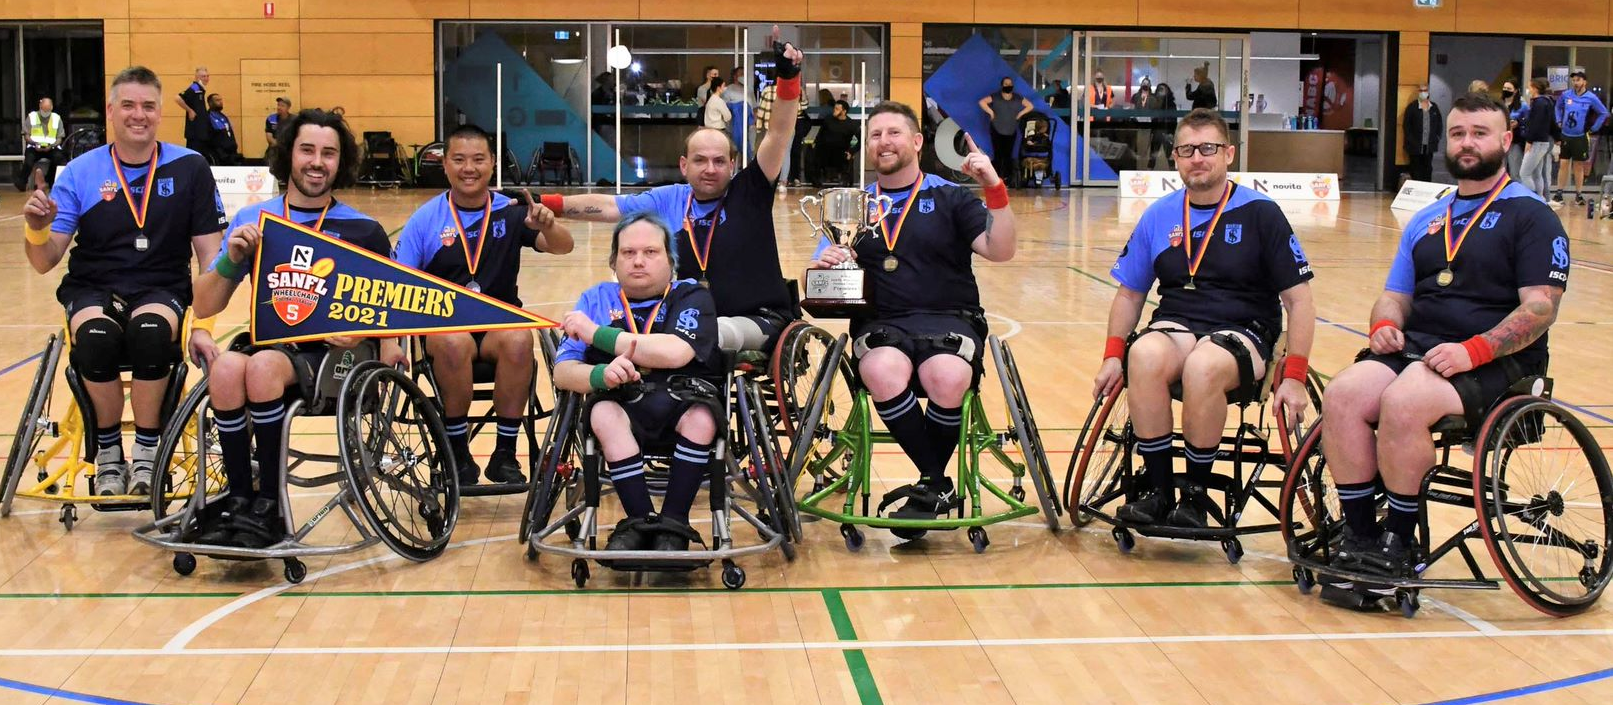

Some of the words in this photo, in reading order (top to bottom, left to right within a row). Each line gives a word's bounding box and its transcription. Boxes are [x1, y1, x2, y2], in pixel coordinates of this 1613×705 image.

[218, 216, 227, 225] IS
[267, 271, 328, 296] SANFL
[273, 289, 319, 302] WHEELCHAIR
[332, 273, 457, 318] PREMIERS
[286, 304, 299, 321] S
[328, 302, 388, 327] 2021
[312, 506, 329, 522] orion
